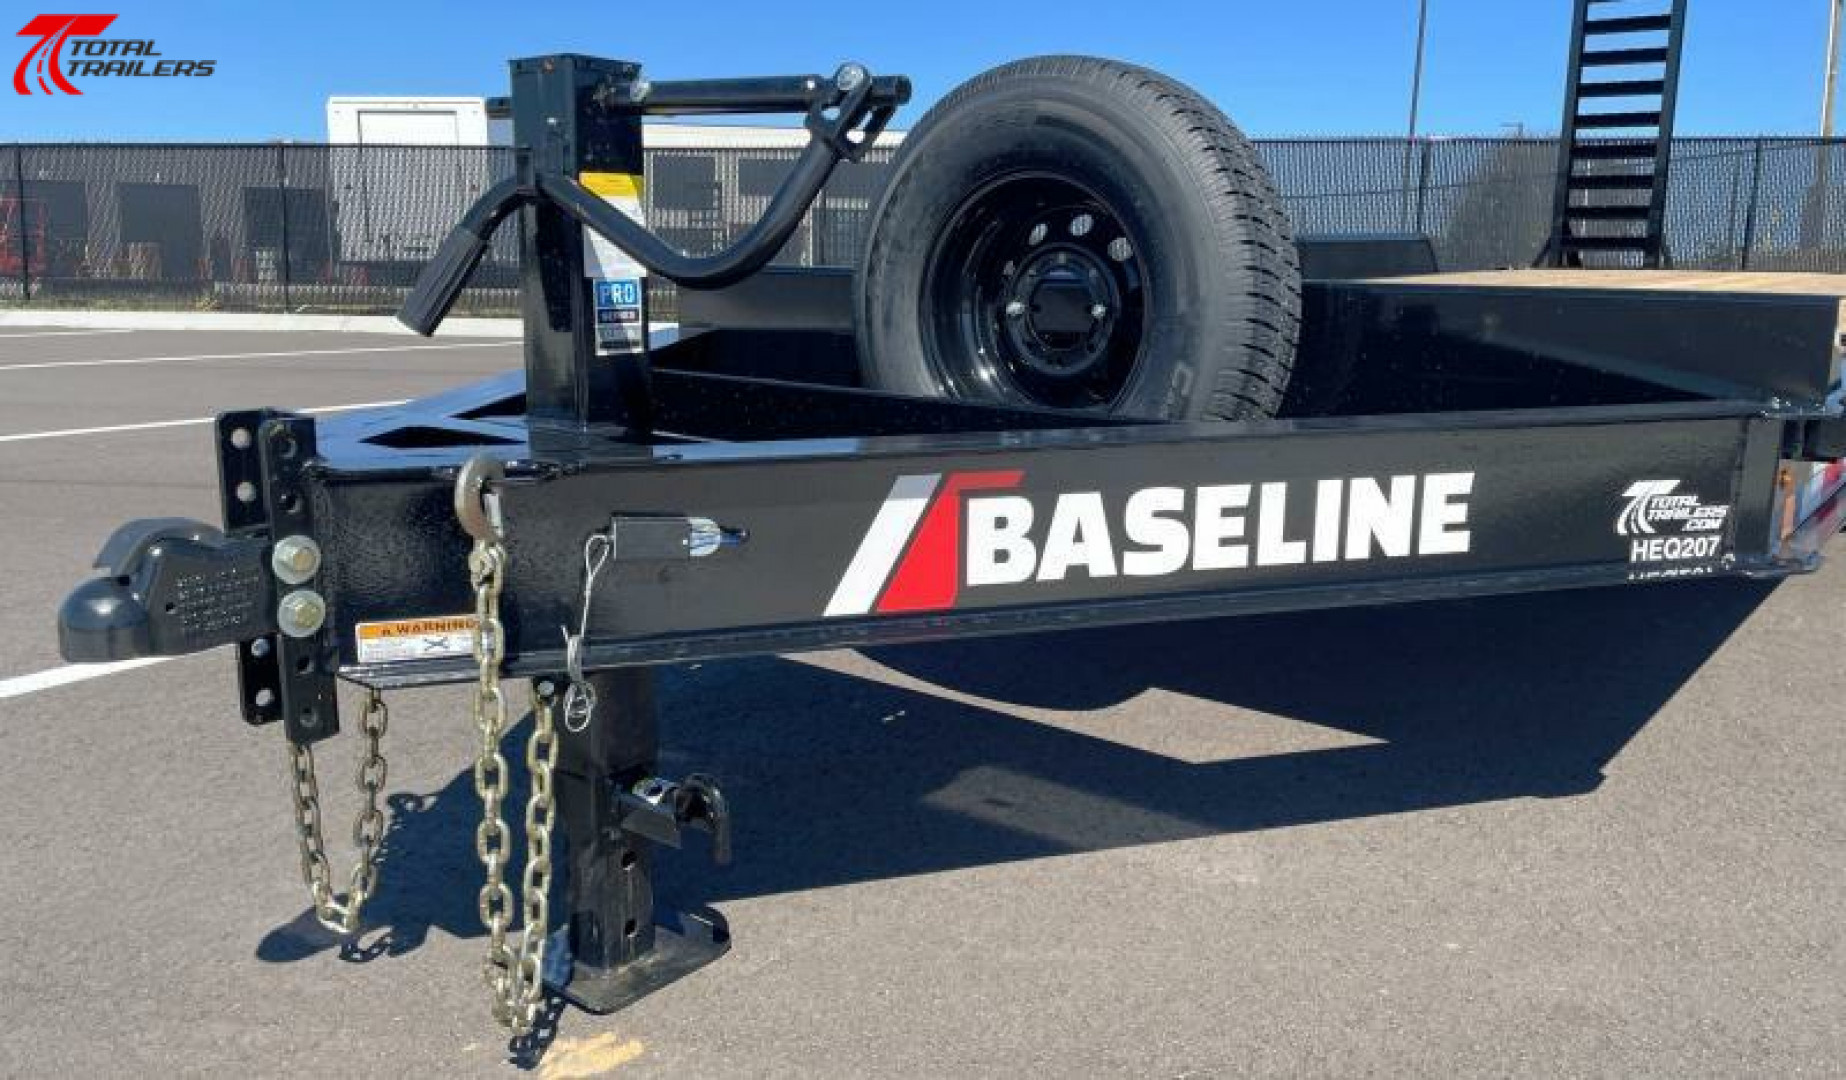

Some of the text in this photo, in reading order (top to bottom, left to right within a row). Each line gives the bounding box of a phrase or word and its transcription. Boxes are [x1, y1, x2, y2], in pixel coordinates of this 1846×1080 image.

[599, 283, 635, 305] PRO
[1647, 505, 1730, 520] TRAILERS
[1650, 495, 1701, 509] TOTAL
[967, 472, 1475, 586] BASELINE
[1629, 535, 1721, 562] HEQ207
